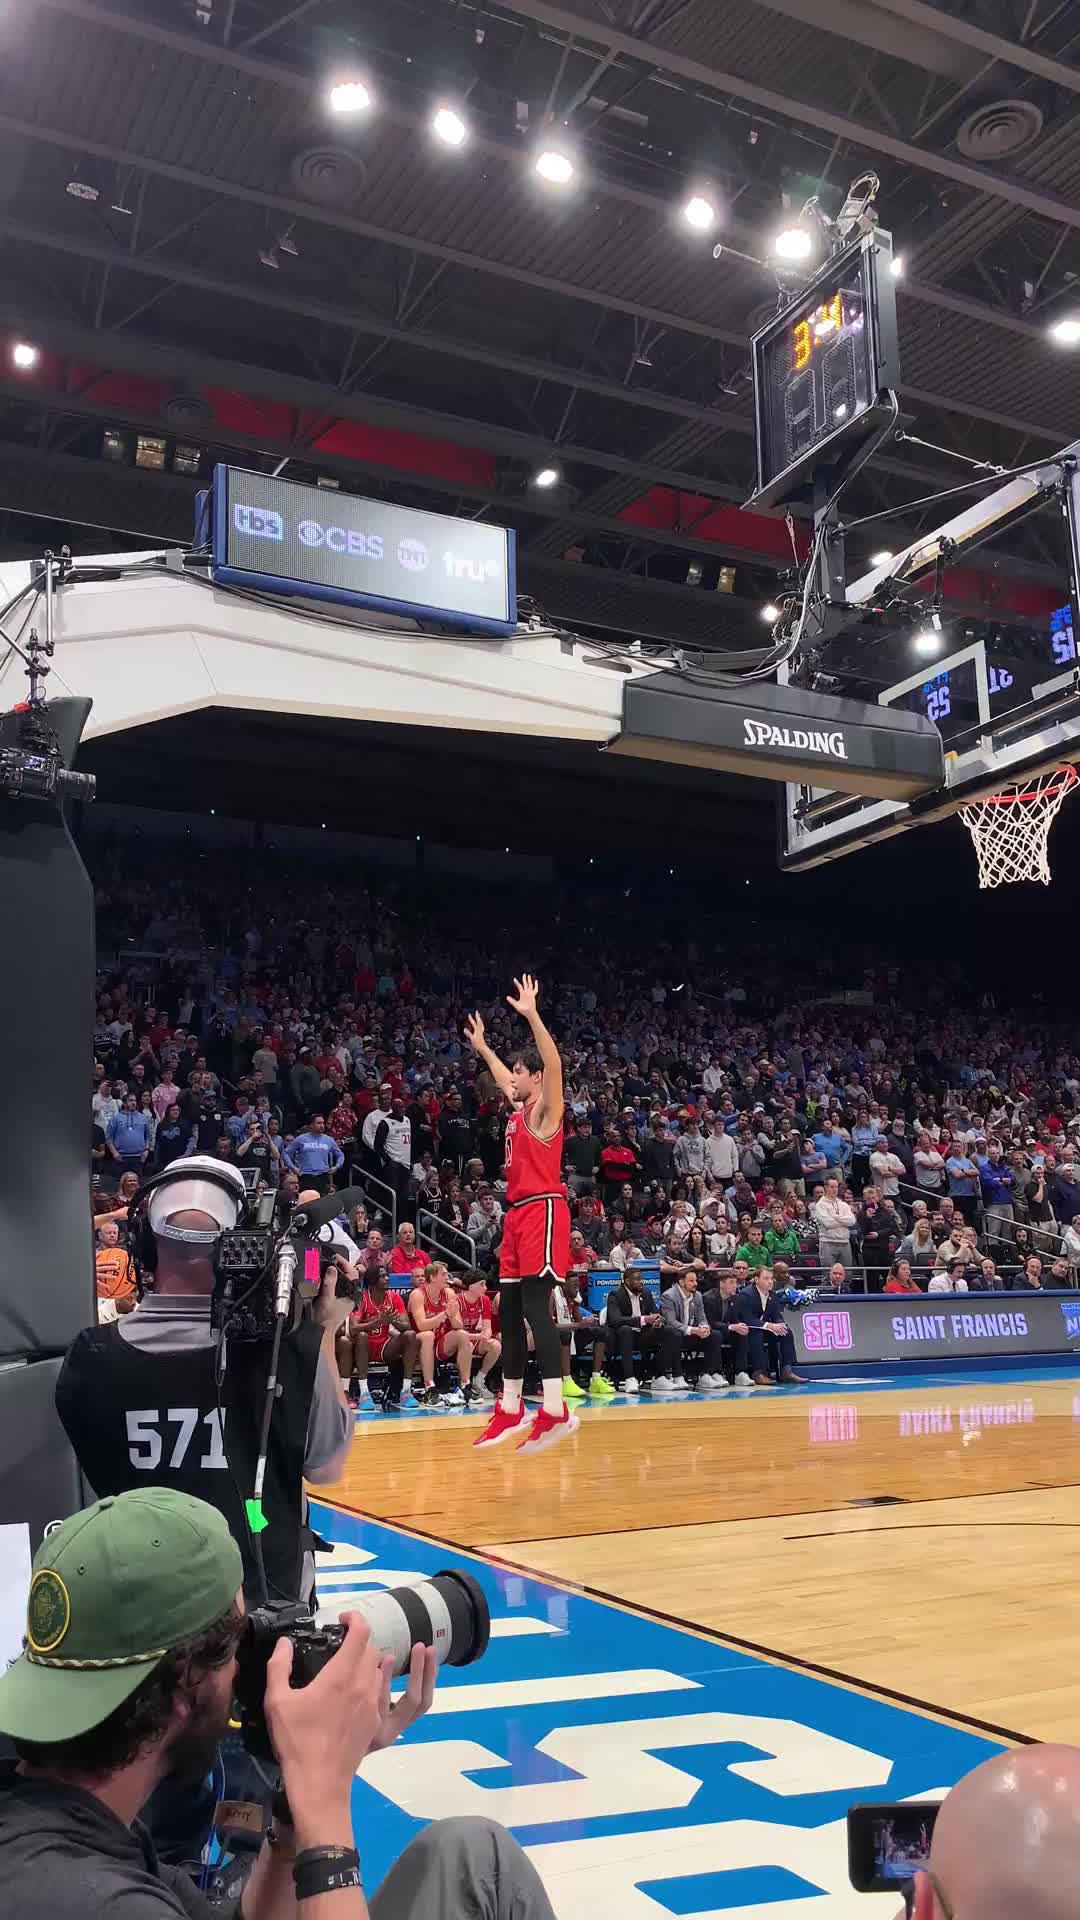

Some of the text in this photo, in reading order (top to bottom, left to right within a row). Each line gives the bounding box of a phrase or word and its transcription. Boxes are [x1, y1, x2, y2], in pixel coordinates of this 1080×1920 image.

[326, 526, 384, 560] CBS
[743, 718, 848, 759] SPALDING
[803, 1312, 852, 1350] SFU
[892, 1312, 1029, 1340] SAINT FRANCIS
[125, 1407, 229, 1470] 571
